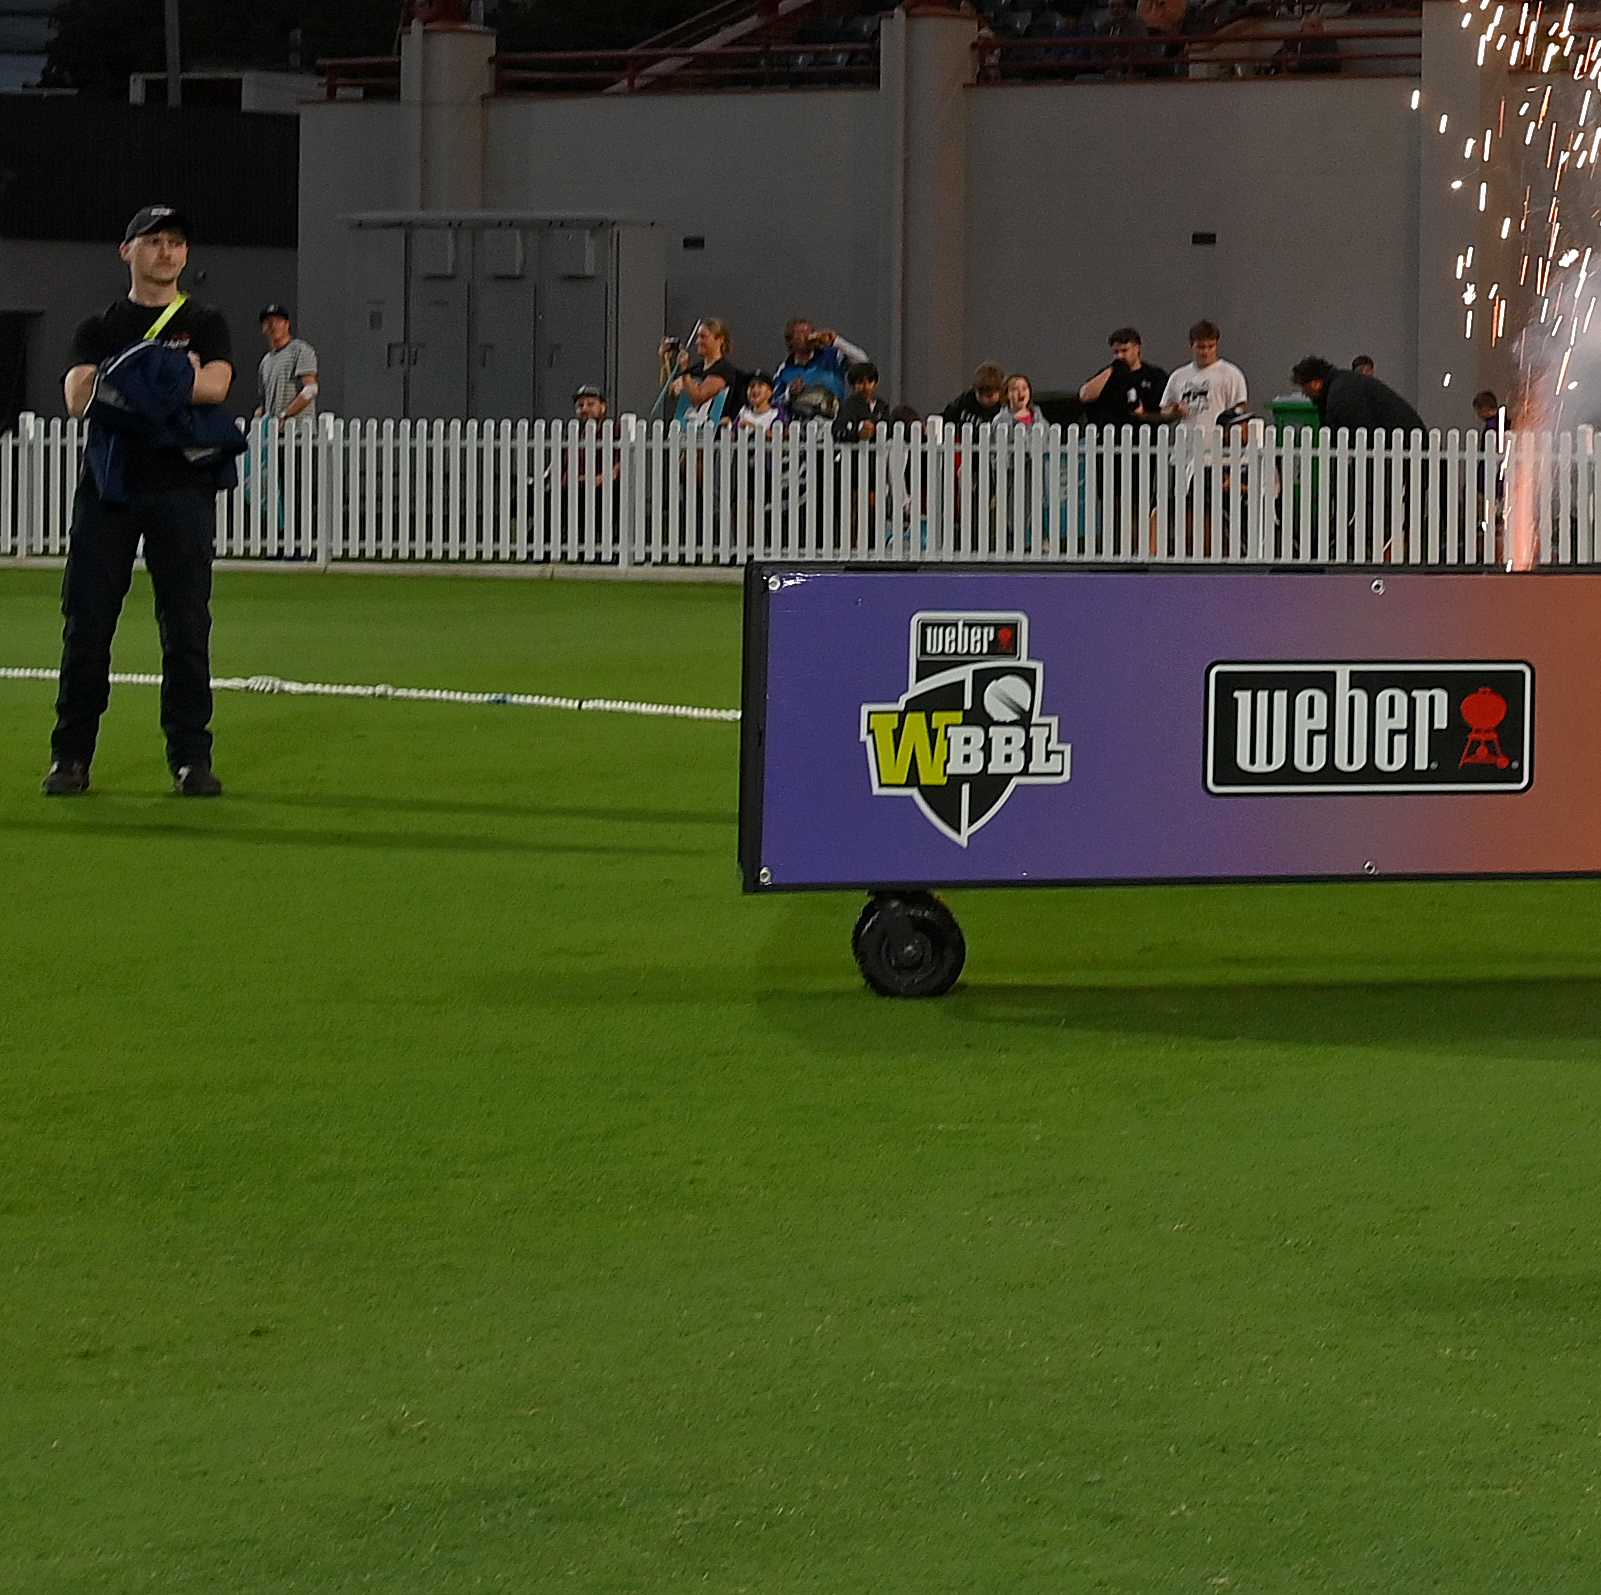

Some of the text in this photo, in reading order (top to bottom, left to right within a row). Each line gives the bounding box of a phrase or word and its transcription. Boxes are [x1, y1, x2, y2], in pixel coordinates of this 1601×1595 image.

[925, 620, 995, 655] weber
[869, 710, 1063, 786] WBBL
[1232, 668, 1449, 773] weber
